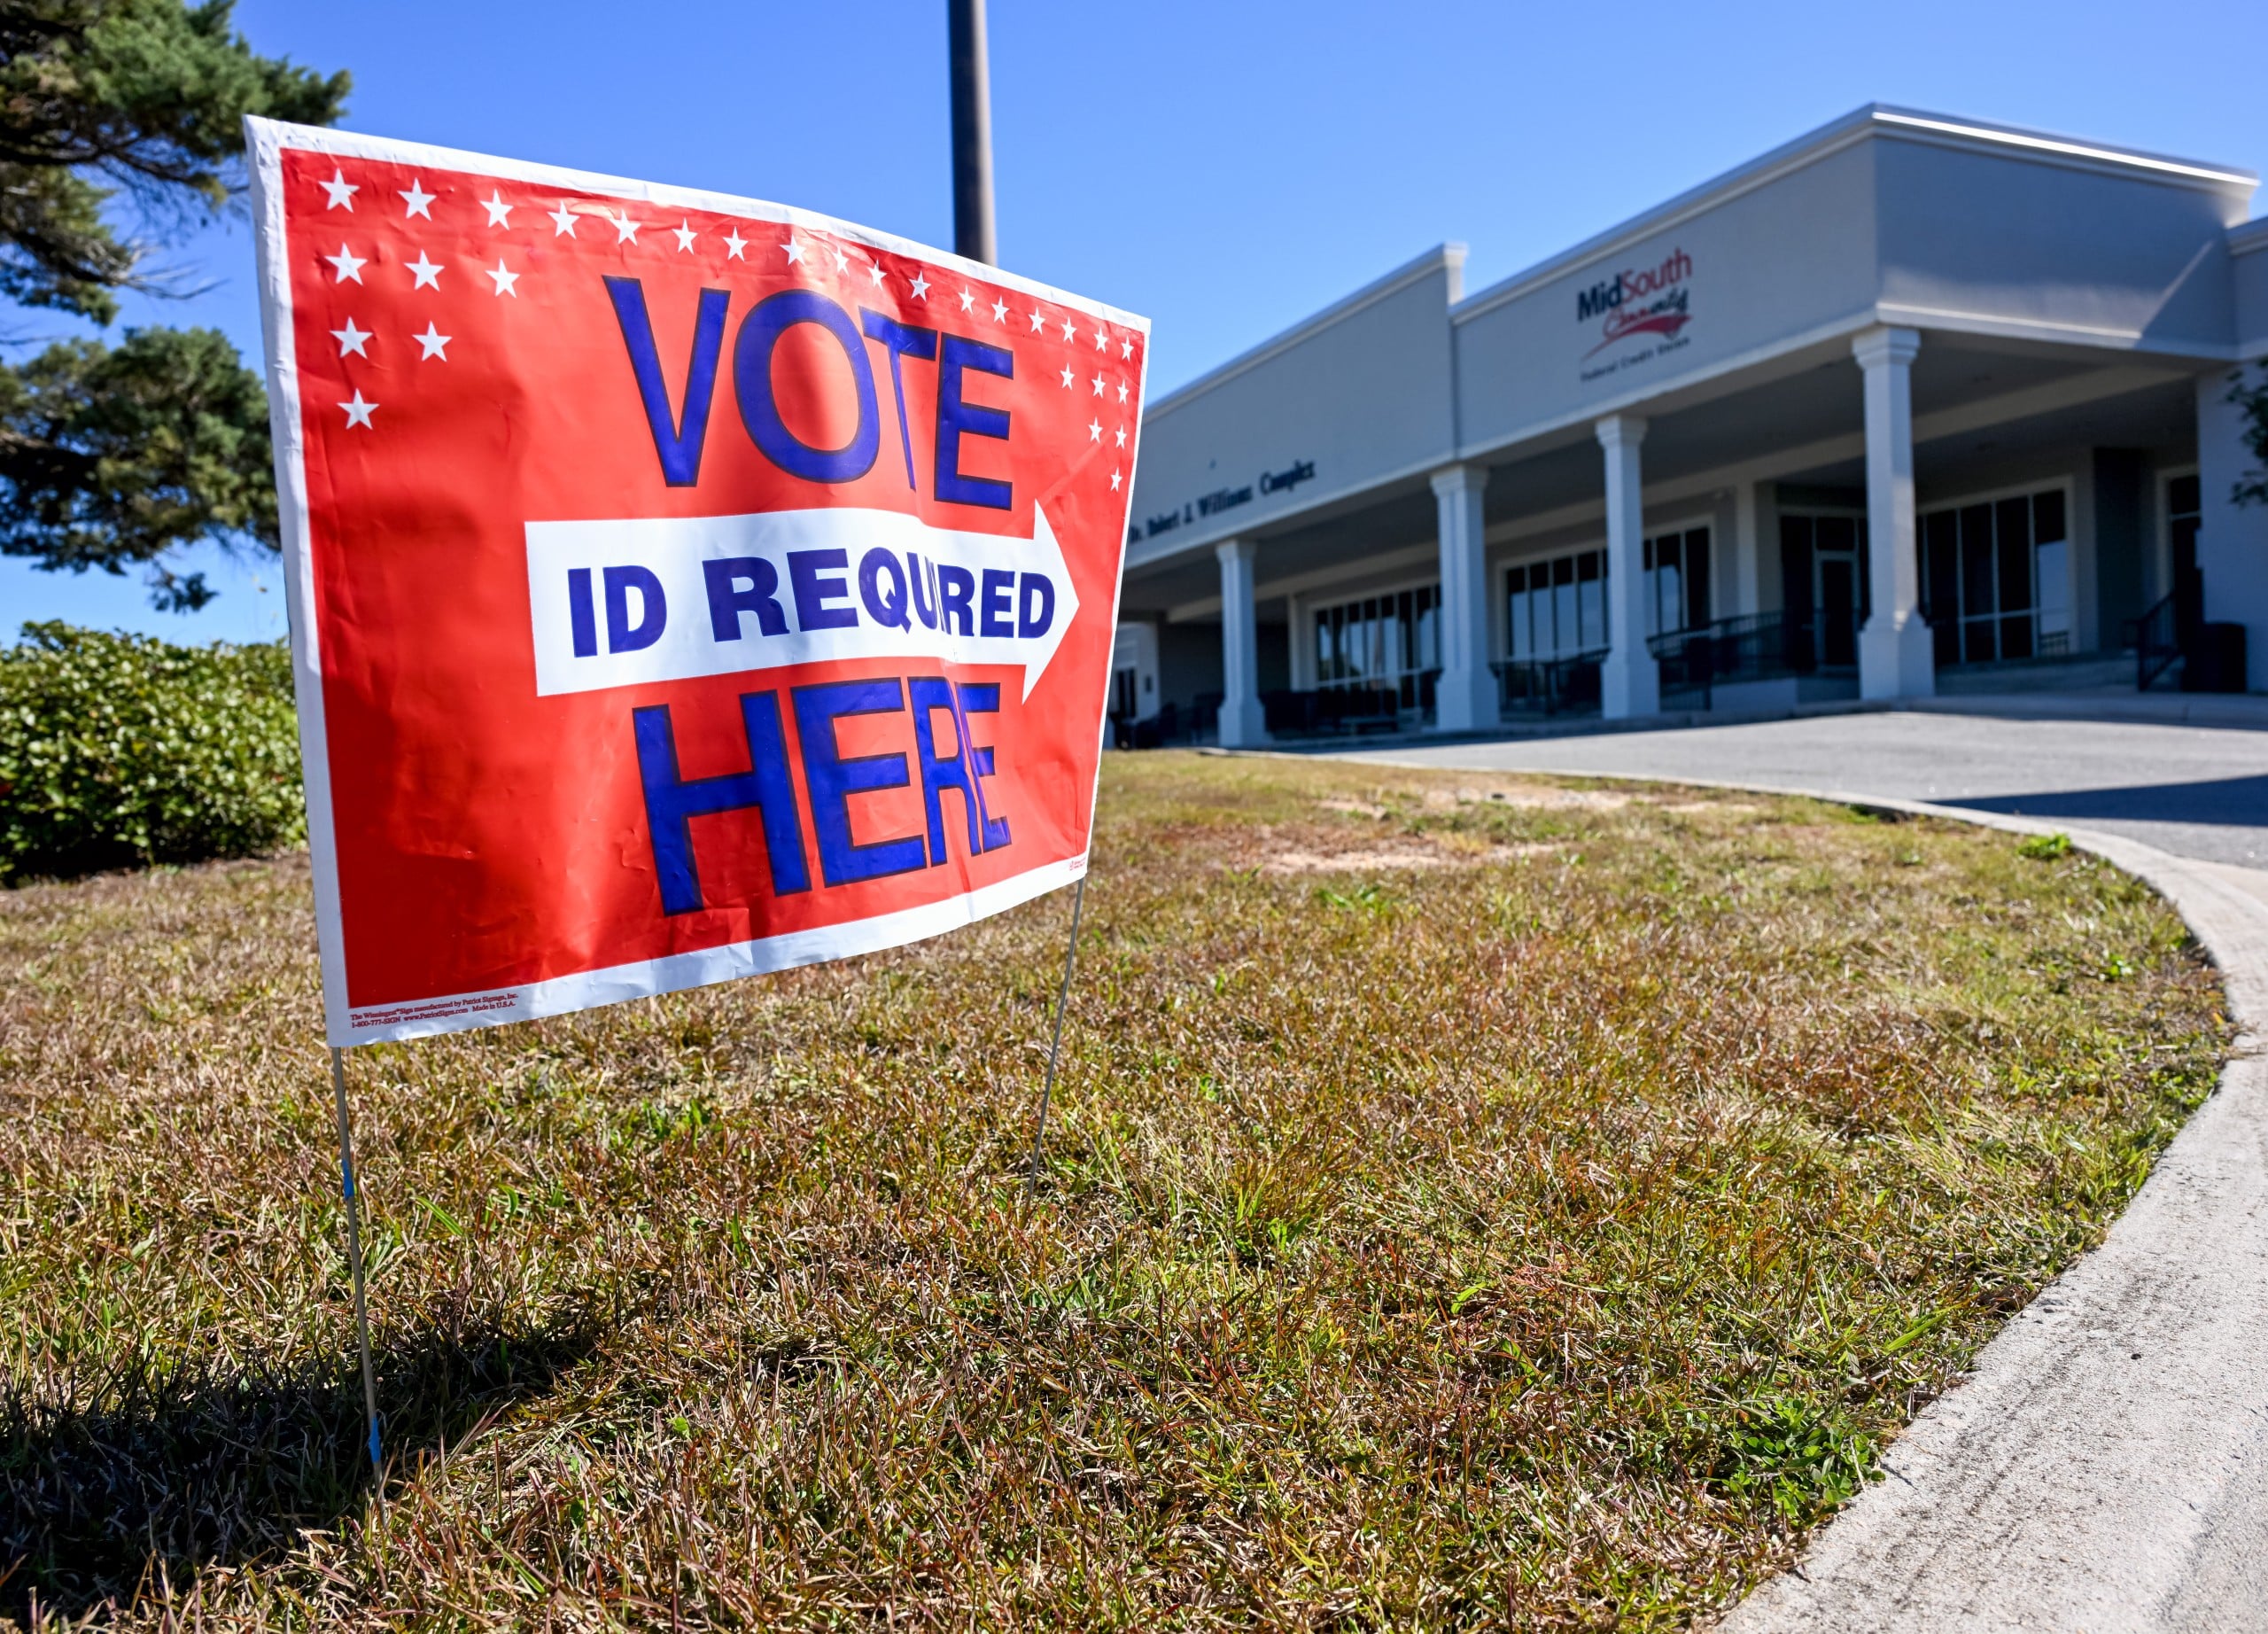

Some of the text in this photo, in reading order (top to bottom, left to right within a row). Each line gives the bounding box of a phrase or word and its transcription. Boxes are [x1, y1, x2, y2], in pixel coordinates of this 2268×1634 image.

[1577, 246, 1692, 323] MidSouth
[602, 275, 1014, 511] VOTE
[1259, 459, 1316, 495] Complex
[567, 564, 668, 658] ID
[631, 676, 1013, 917] HERE
[414, 1001, 453, 1012] manufactured
